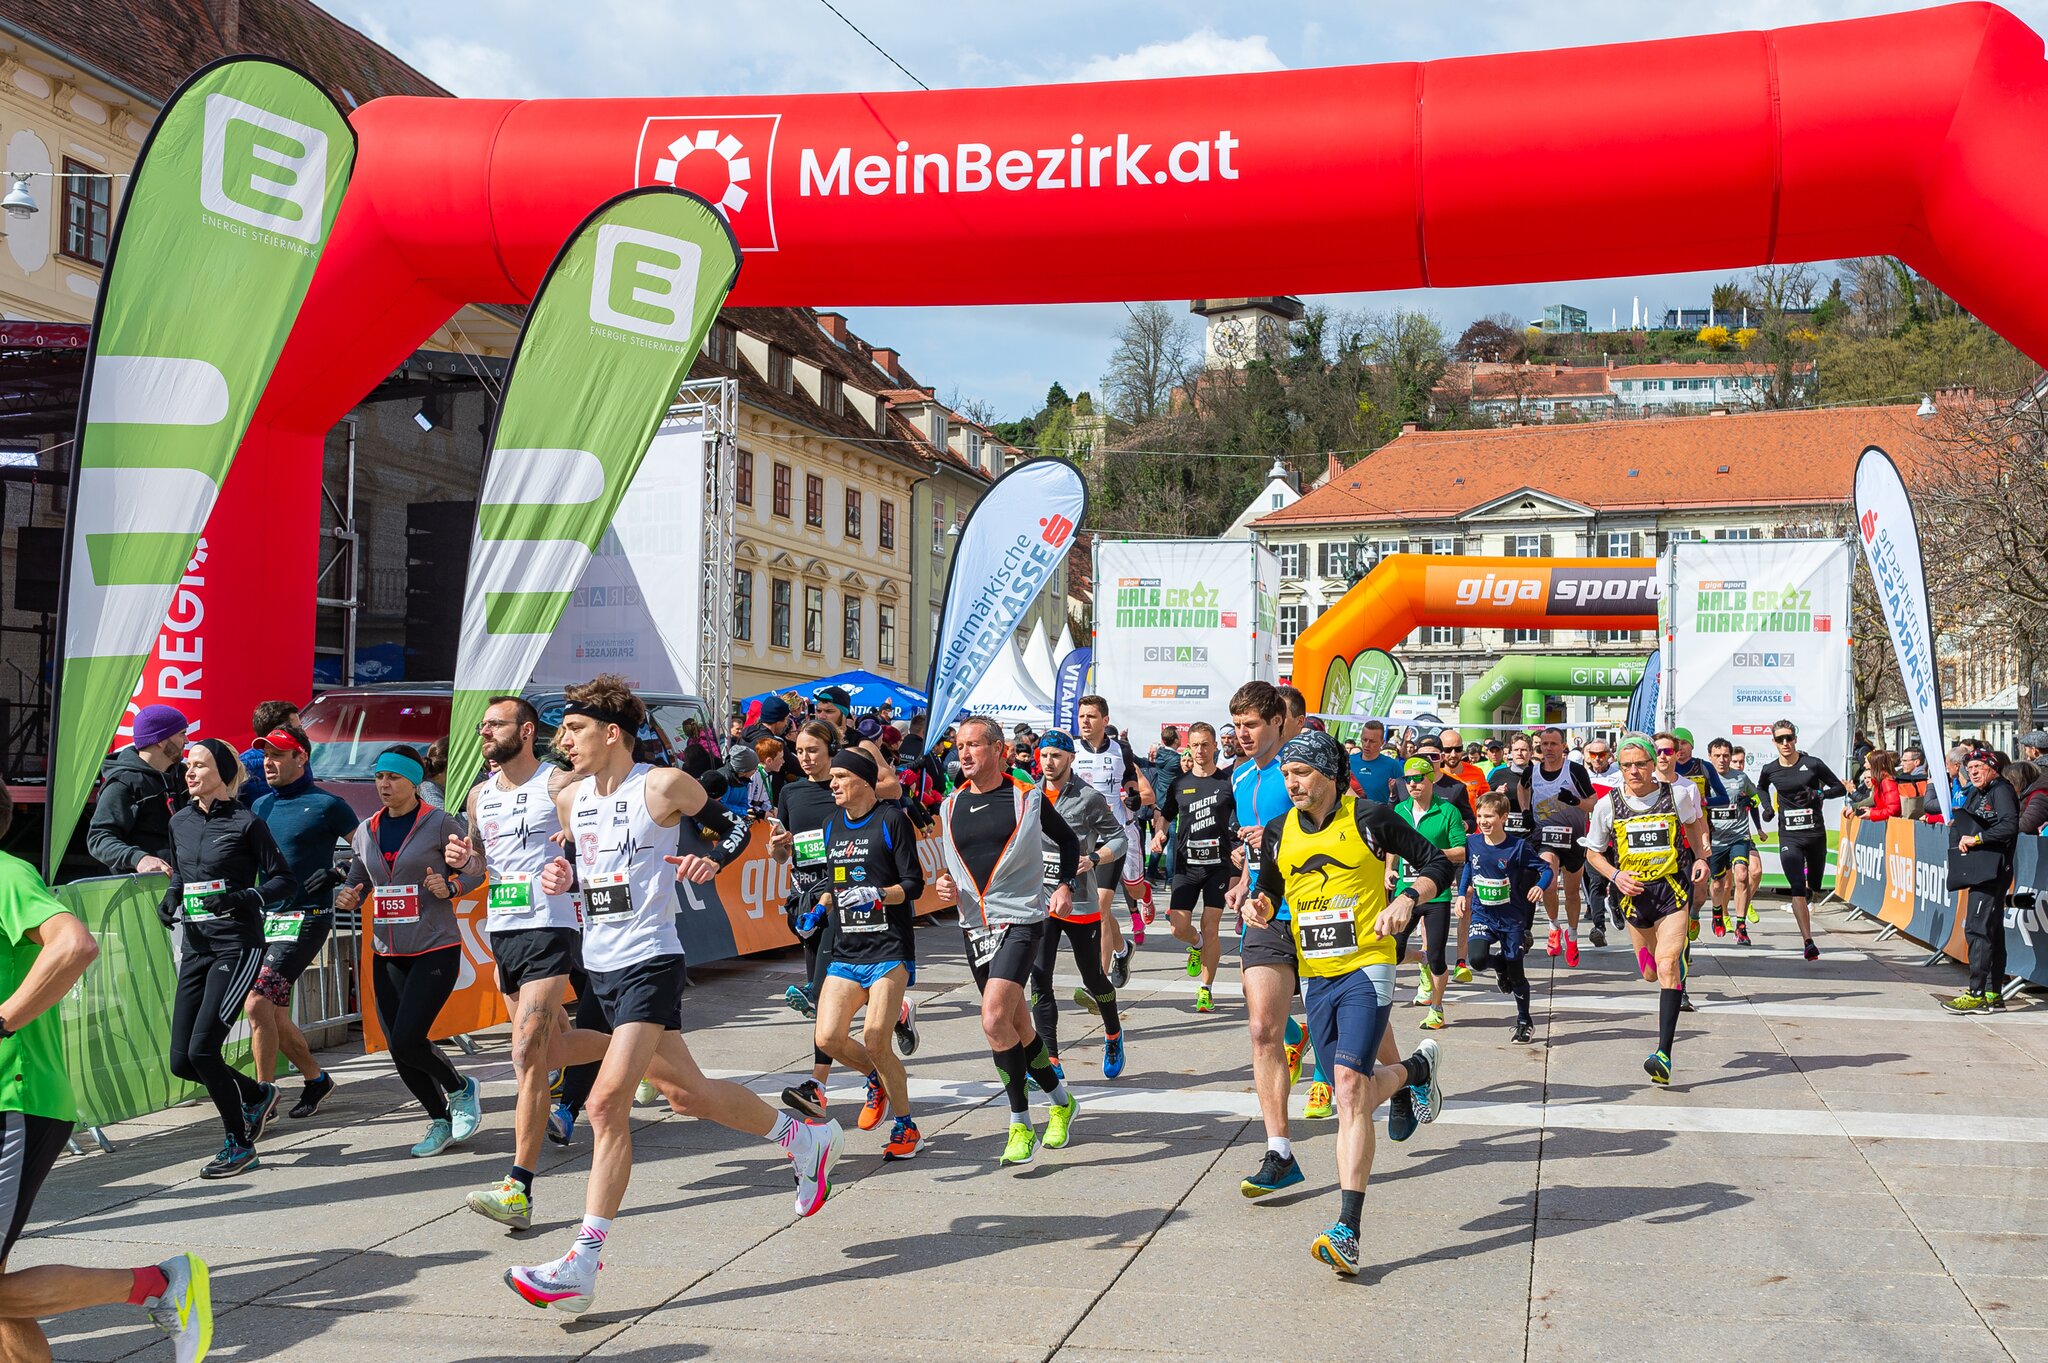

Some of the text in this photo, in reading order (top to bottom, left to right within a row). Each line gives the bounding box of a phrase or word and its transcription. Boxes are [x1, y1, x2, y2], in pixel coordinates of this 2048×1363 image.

[799, 130, 1240, 197] MeinBezirk.at
[202, 213, 318, 259] ENERGIE STEIERMARK
[590, 325, 688, 354] ENERGIE STEIERMARK
[1455, 573, 1662, 607] giga sport
[1724, 581, 1745, 589] sport
[1116, 579, 1219, 608] HALB GRAZ
[1697, 581, 1812, 611] HALB GRAZ
[947, 543, 1055, 706] SPARKASSE
[1115, 608, 1219, 628] MARATHON
[1695, 612, 1812, 633] MARATHON
[1144, 648, 1208, 661] GRAZ
[1734, 654, 1792, 666] GRAZ
[1150, 686, 1207, 697] giga sport
[972, 704, 1028, 712] VITAMIN
[1188, 794, 1218, 813] ATHLETIK
[1195, 810, 1211, 820] CLUB
[1190, 818, 1216, 834] MURTAL
[1639, 832, 1658, 842] 496
[803, 841, 826, 853] 1382
[1043, 863, 1060, 874] 725
[1855, 842, 1884, 885] sport
[1888, 843, 1951, 912] giga sport
[494, 886, 518, 899] 1112
[591, 890, 612, 906] 604
[1482, 887, 1502, 896] 1161
[381, 899, 406, 911] 1553
[1311, 927, 1337, 941] 742
[979, 939, 997, 952] 889
